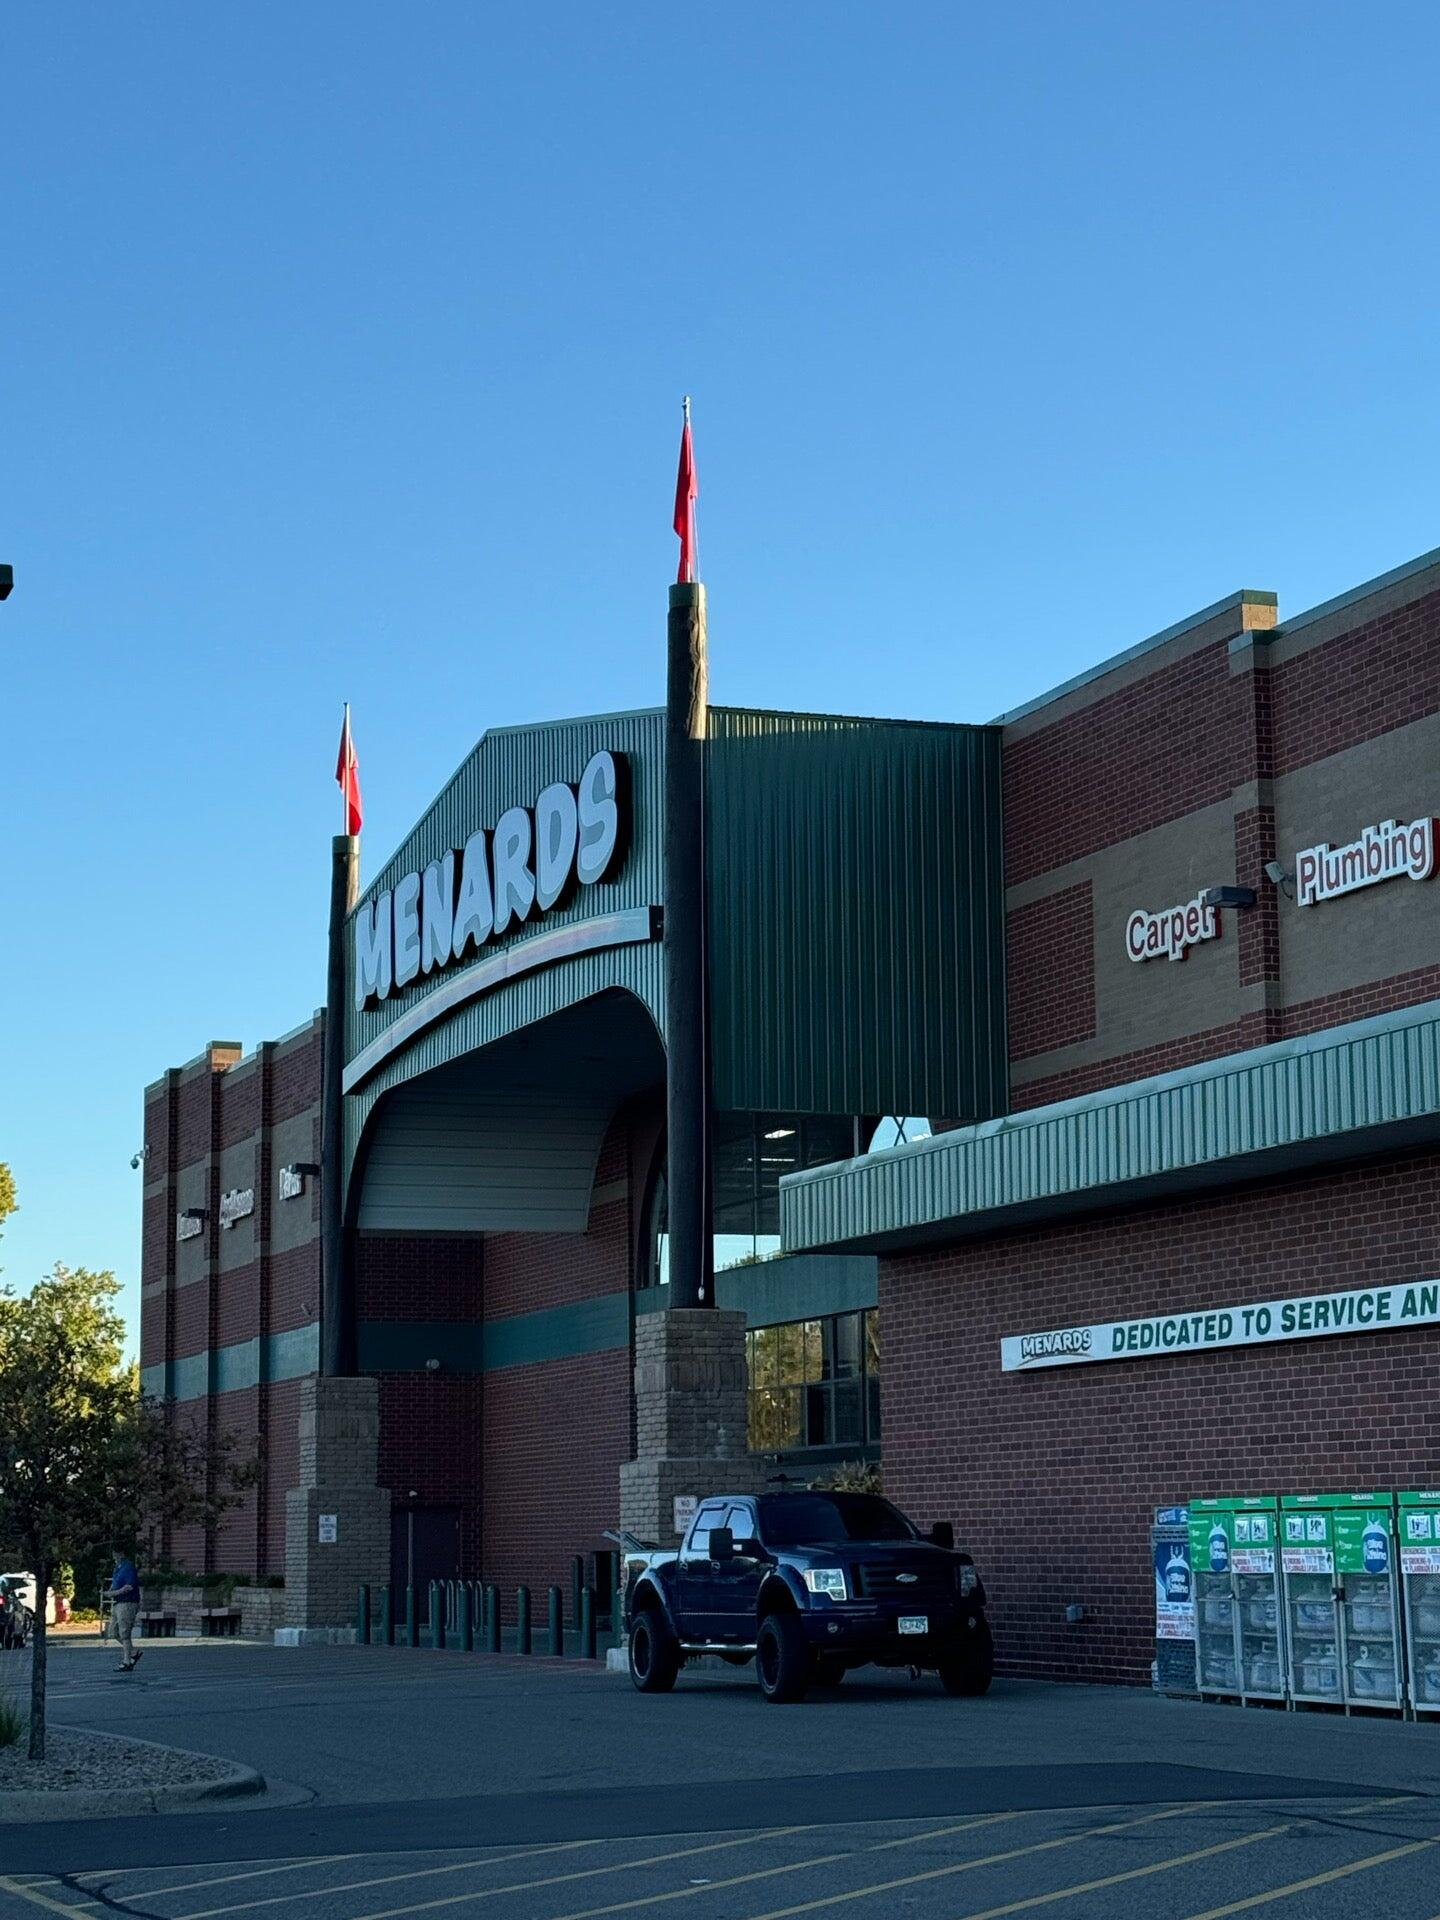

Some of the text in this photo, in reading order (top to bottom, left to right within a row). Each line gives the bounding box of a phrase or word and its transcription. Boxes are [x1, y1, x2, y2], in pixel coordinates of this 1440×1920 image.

[355, 750, 618, 1012] MENARDS
[1296, 817, 1433, 906] Plumbing
[1127, 889, 1217, 962] Carpet
[1020, 1285, 1438, 1358] MENARDS DEDICATED TO SERVICE AN
